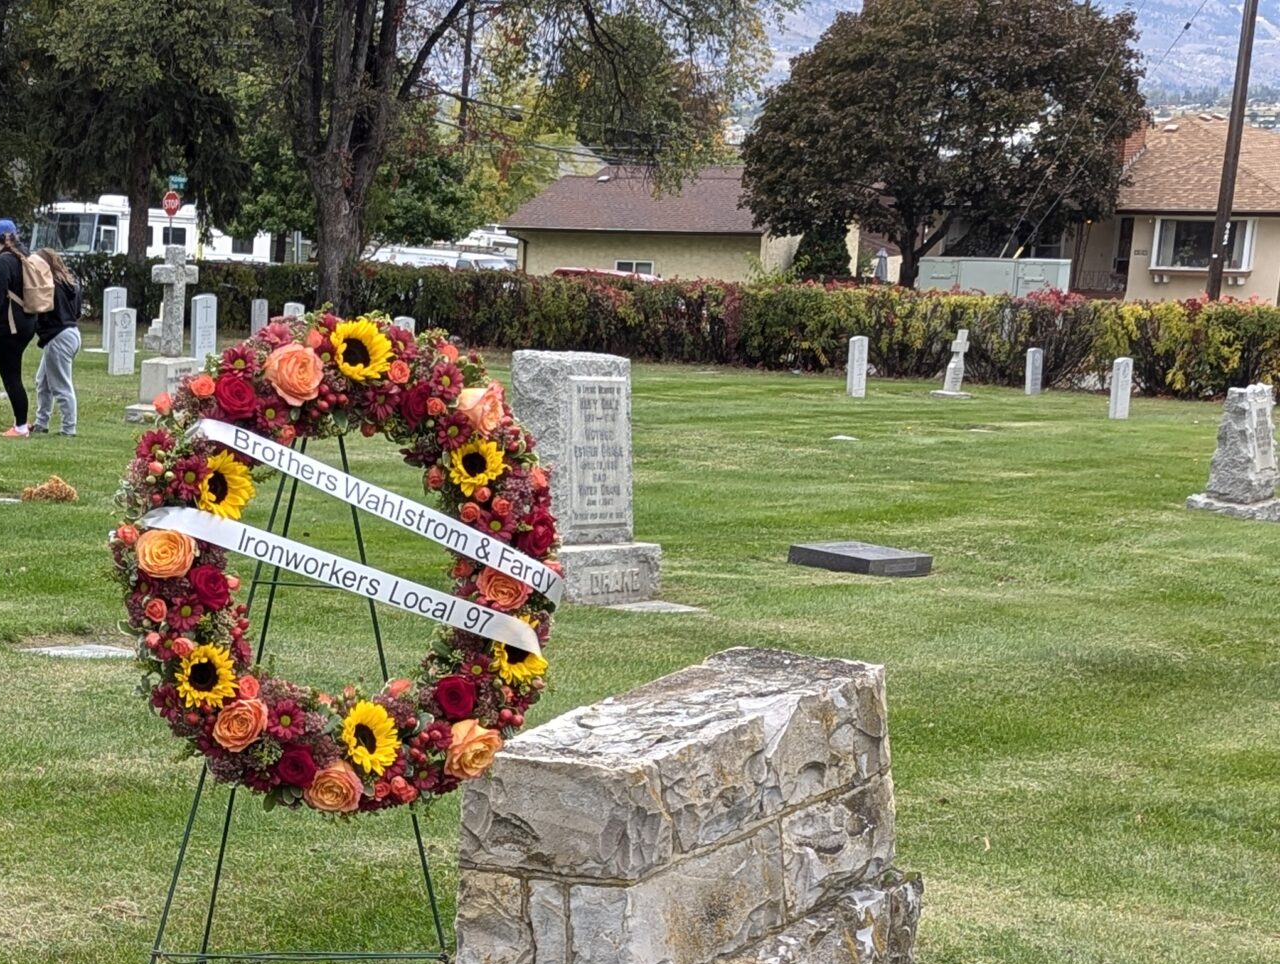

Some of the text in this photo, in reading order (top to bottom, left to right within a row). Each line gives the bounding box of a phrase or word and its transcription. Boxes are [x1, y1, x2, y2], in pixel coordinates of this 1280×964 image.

[165, 199, 179, 210] STOP
[233, 428, 558, 594] Brothers Wahlstrom & Fardy
[238, 528, 495, 634] Ironworkers Local 97
[590, 567, 639, 595] DRAKE
